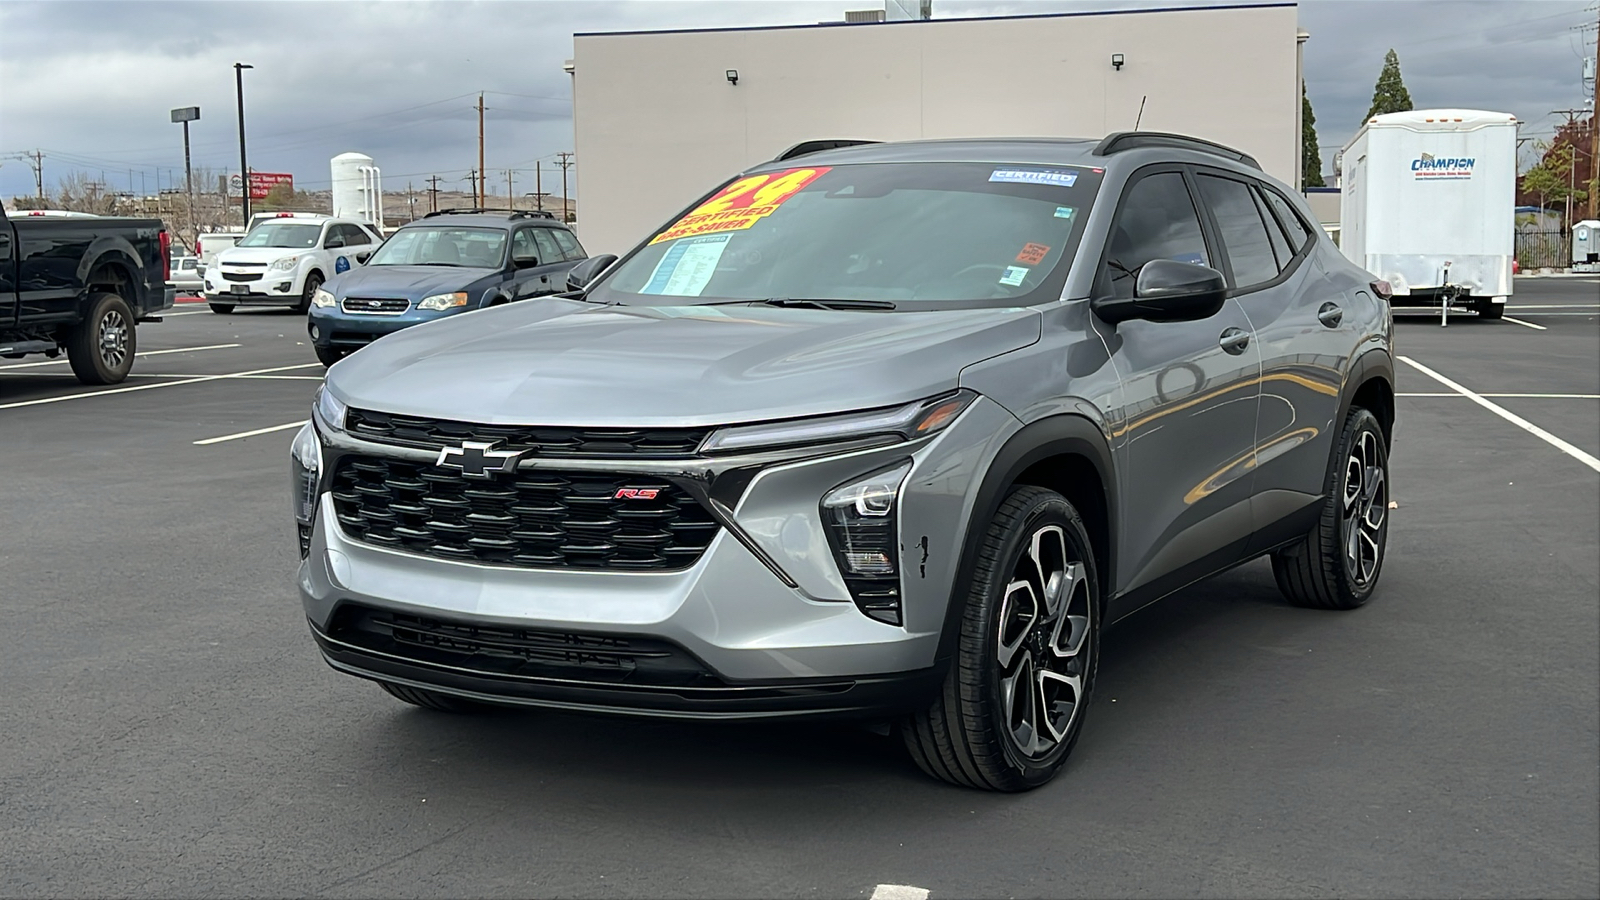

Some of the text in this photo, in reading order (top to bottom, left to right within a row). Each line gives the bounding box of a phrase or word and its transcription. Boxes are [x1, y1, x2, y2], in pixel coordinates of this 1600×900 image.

[1411, 158, 1475, 171] CHAMPION
[995, 170, 1072, 182] CERTIFIED
[673, 206, 774, 228] CERTIFIED
[656, 218, 751, 242] GAS-SAVER
[615, 489, 660, 499] RS
